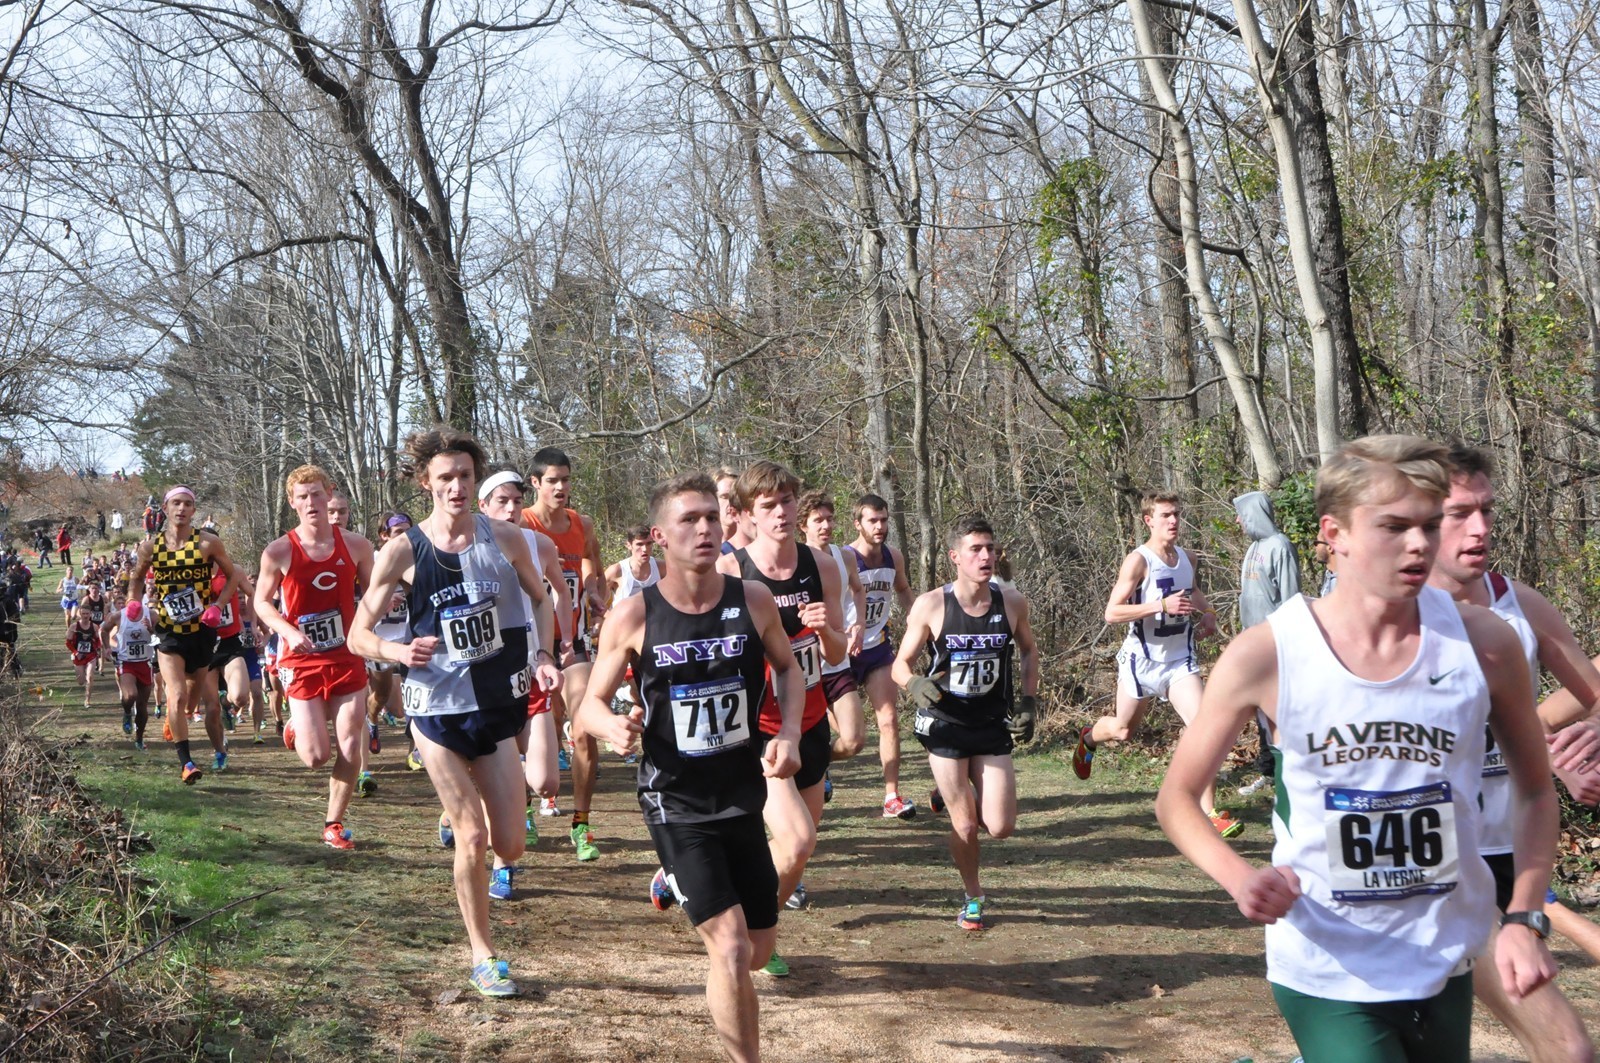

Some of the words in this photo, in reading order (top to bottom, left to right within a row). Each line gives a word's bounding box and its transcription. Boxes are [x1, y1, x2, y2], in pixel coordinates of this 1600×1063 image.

[312, 571, 337, 590] C
[168, 593, 197, 617] 847
[430, 581, 500, 607] GENESEO
[774, 591, 810, 607] HODES
[304, 618, 337, 644] 551
[449, 610, 496, 650] 609
[946, 634, 1007, 648] NYU
[129, 645, 145, 655] 581
[653, 635, 747, 667] NYU
[957, 660, 995, 685] 713
[680, 693, 741, 737] 712
[707, 735, 723, 747] NYU
[1306, 727, 1348, 754] LA
[1347, 721, 1456, 754] VERNE
[1322, 746, 1441, 767] LEOPARDS
[1340, 808, 1443, 869] 646
[1363, 871, 1380, 887] LA
[1384, 869, 1426, 886] VERNE
